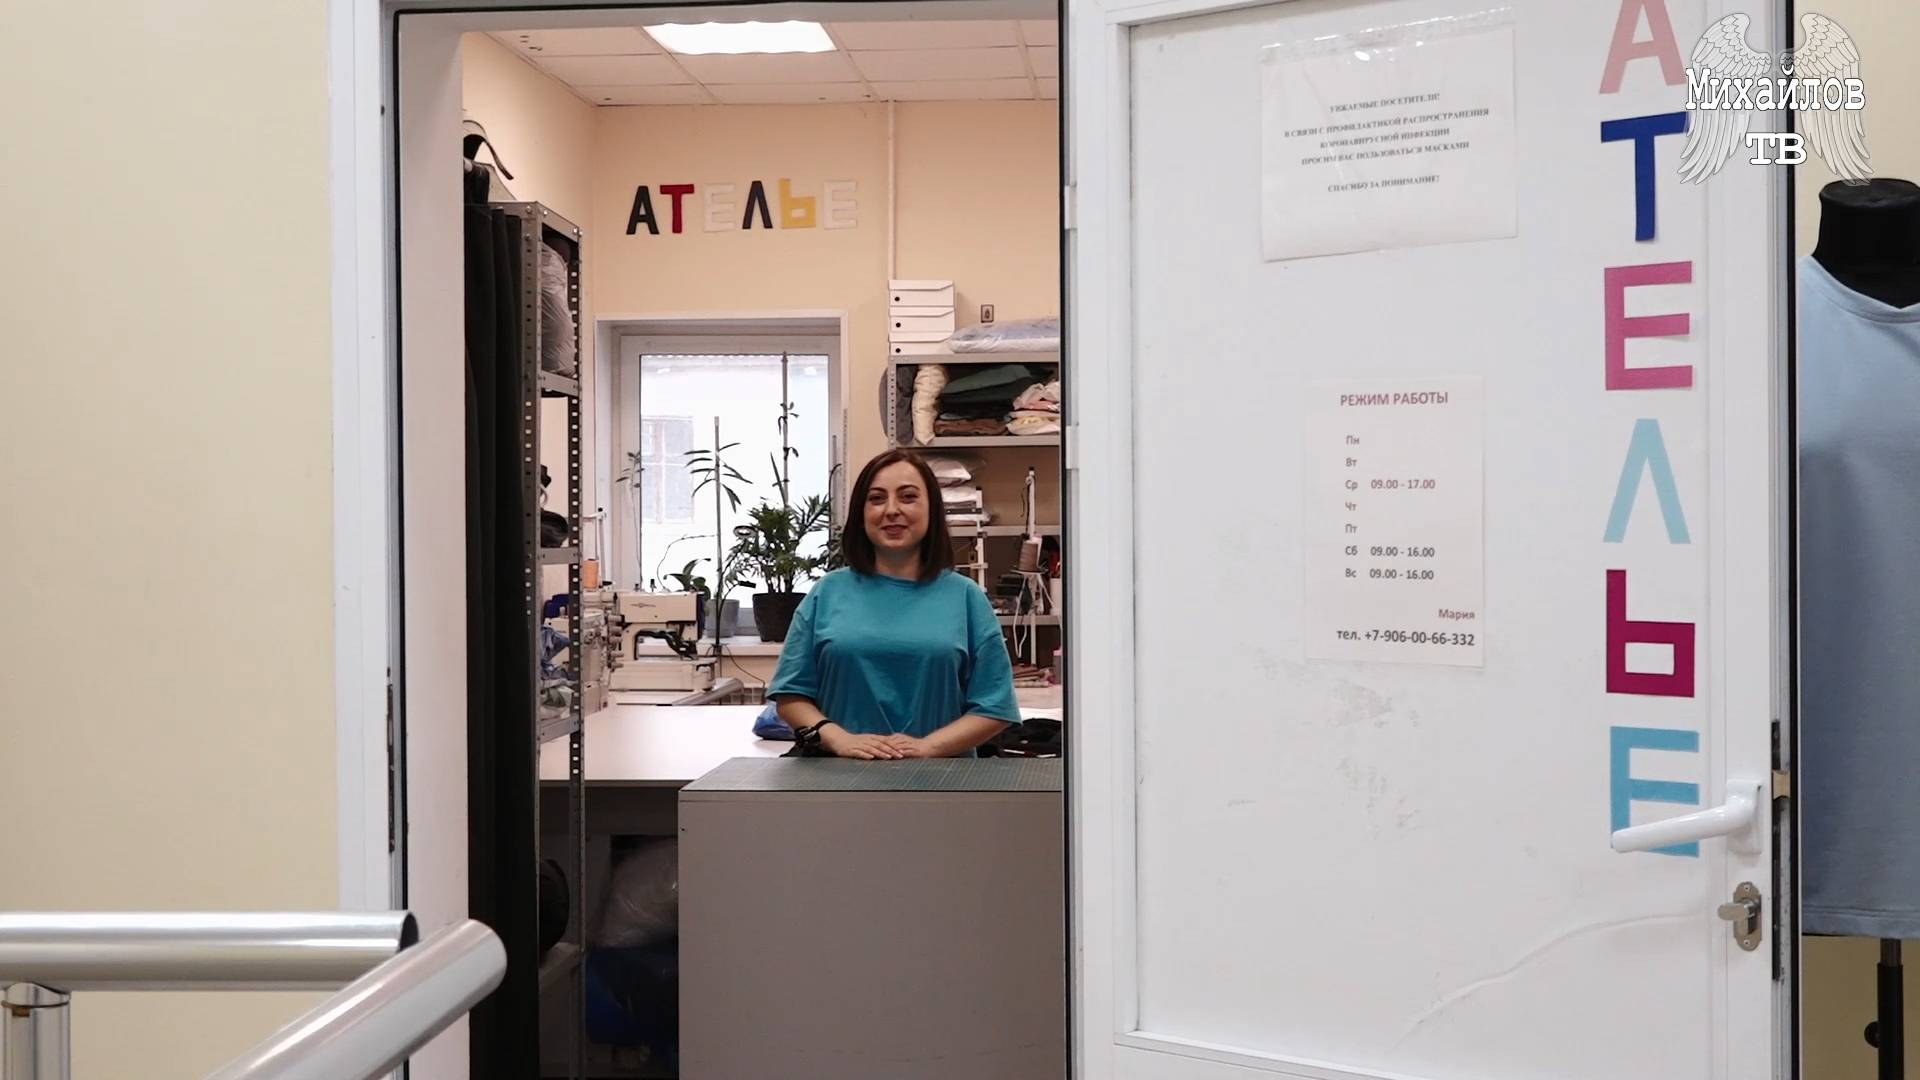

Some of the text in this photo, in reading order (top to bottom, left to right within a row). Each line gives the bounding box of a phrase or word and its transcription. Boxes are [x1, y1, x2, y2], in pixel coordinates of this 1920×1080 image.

[1291, 127, 1318, 137] СВЯЗИ
[1326, 117, 1402, 134] ПРОФИЛАКТИКОЙ
[1402, 108, 1489, 125] РАСПРОСТРАНЕНИЯ
[1320, 128, 1450, 149] КОРОНАВИРУСНОЙ ИНФЕКЦИИ
[1302, 141, 1470, 166] ПРОСИМ ВАС ПОЛЬЗОВАТЬСЯ МАСКАМИ
[1328, 181, 1369, 192] СПАСИБО
[1370, 180, 1380, 189] ЗА
[626, 178, 858, 235] АТЕЛЬЕ
[1340, 391, 1449, 407] РЕЖИМ РАБОТЫ
[1346, 435, 1360, 446] Пн
[1346, 457, 1358, 467] Вт
[1345, 479, 1358, 492] Ср
[1370, 479, 1398, 490] 09.00
[1407, 479, 1436, 490] 17.00
[1345, 502, 1357, 512] Чт
[1345, 524, 1358, 534] Пт
[1345, 545, 1358, 556] Сб
[1370, 546, 1398, 557] 09.00
[1407, 547, 1435, 558] 16.00
[1345, 569, 1357, 578] Вс
[1370, 568, 1397, 579] 09.00
[1406, 569, 1434, 580] 16.00
[1438, 608, 1475, 621] Мария
[1337, 629, 1475, 646] тел. +7-906-00-66-332
